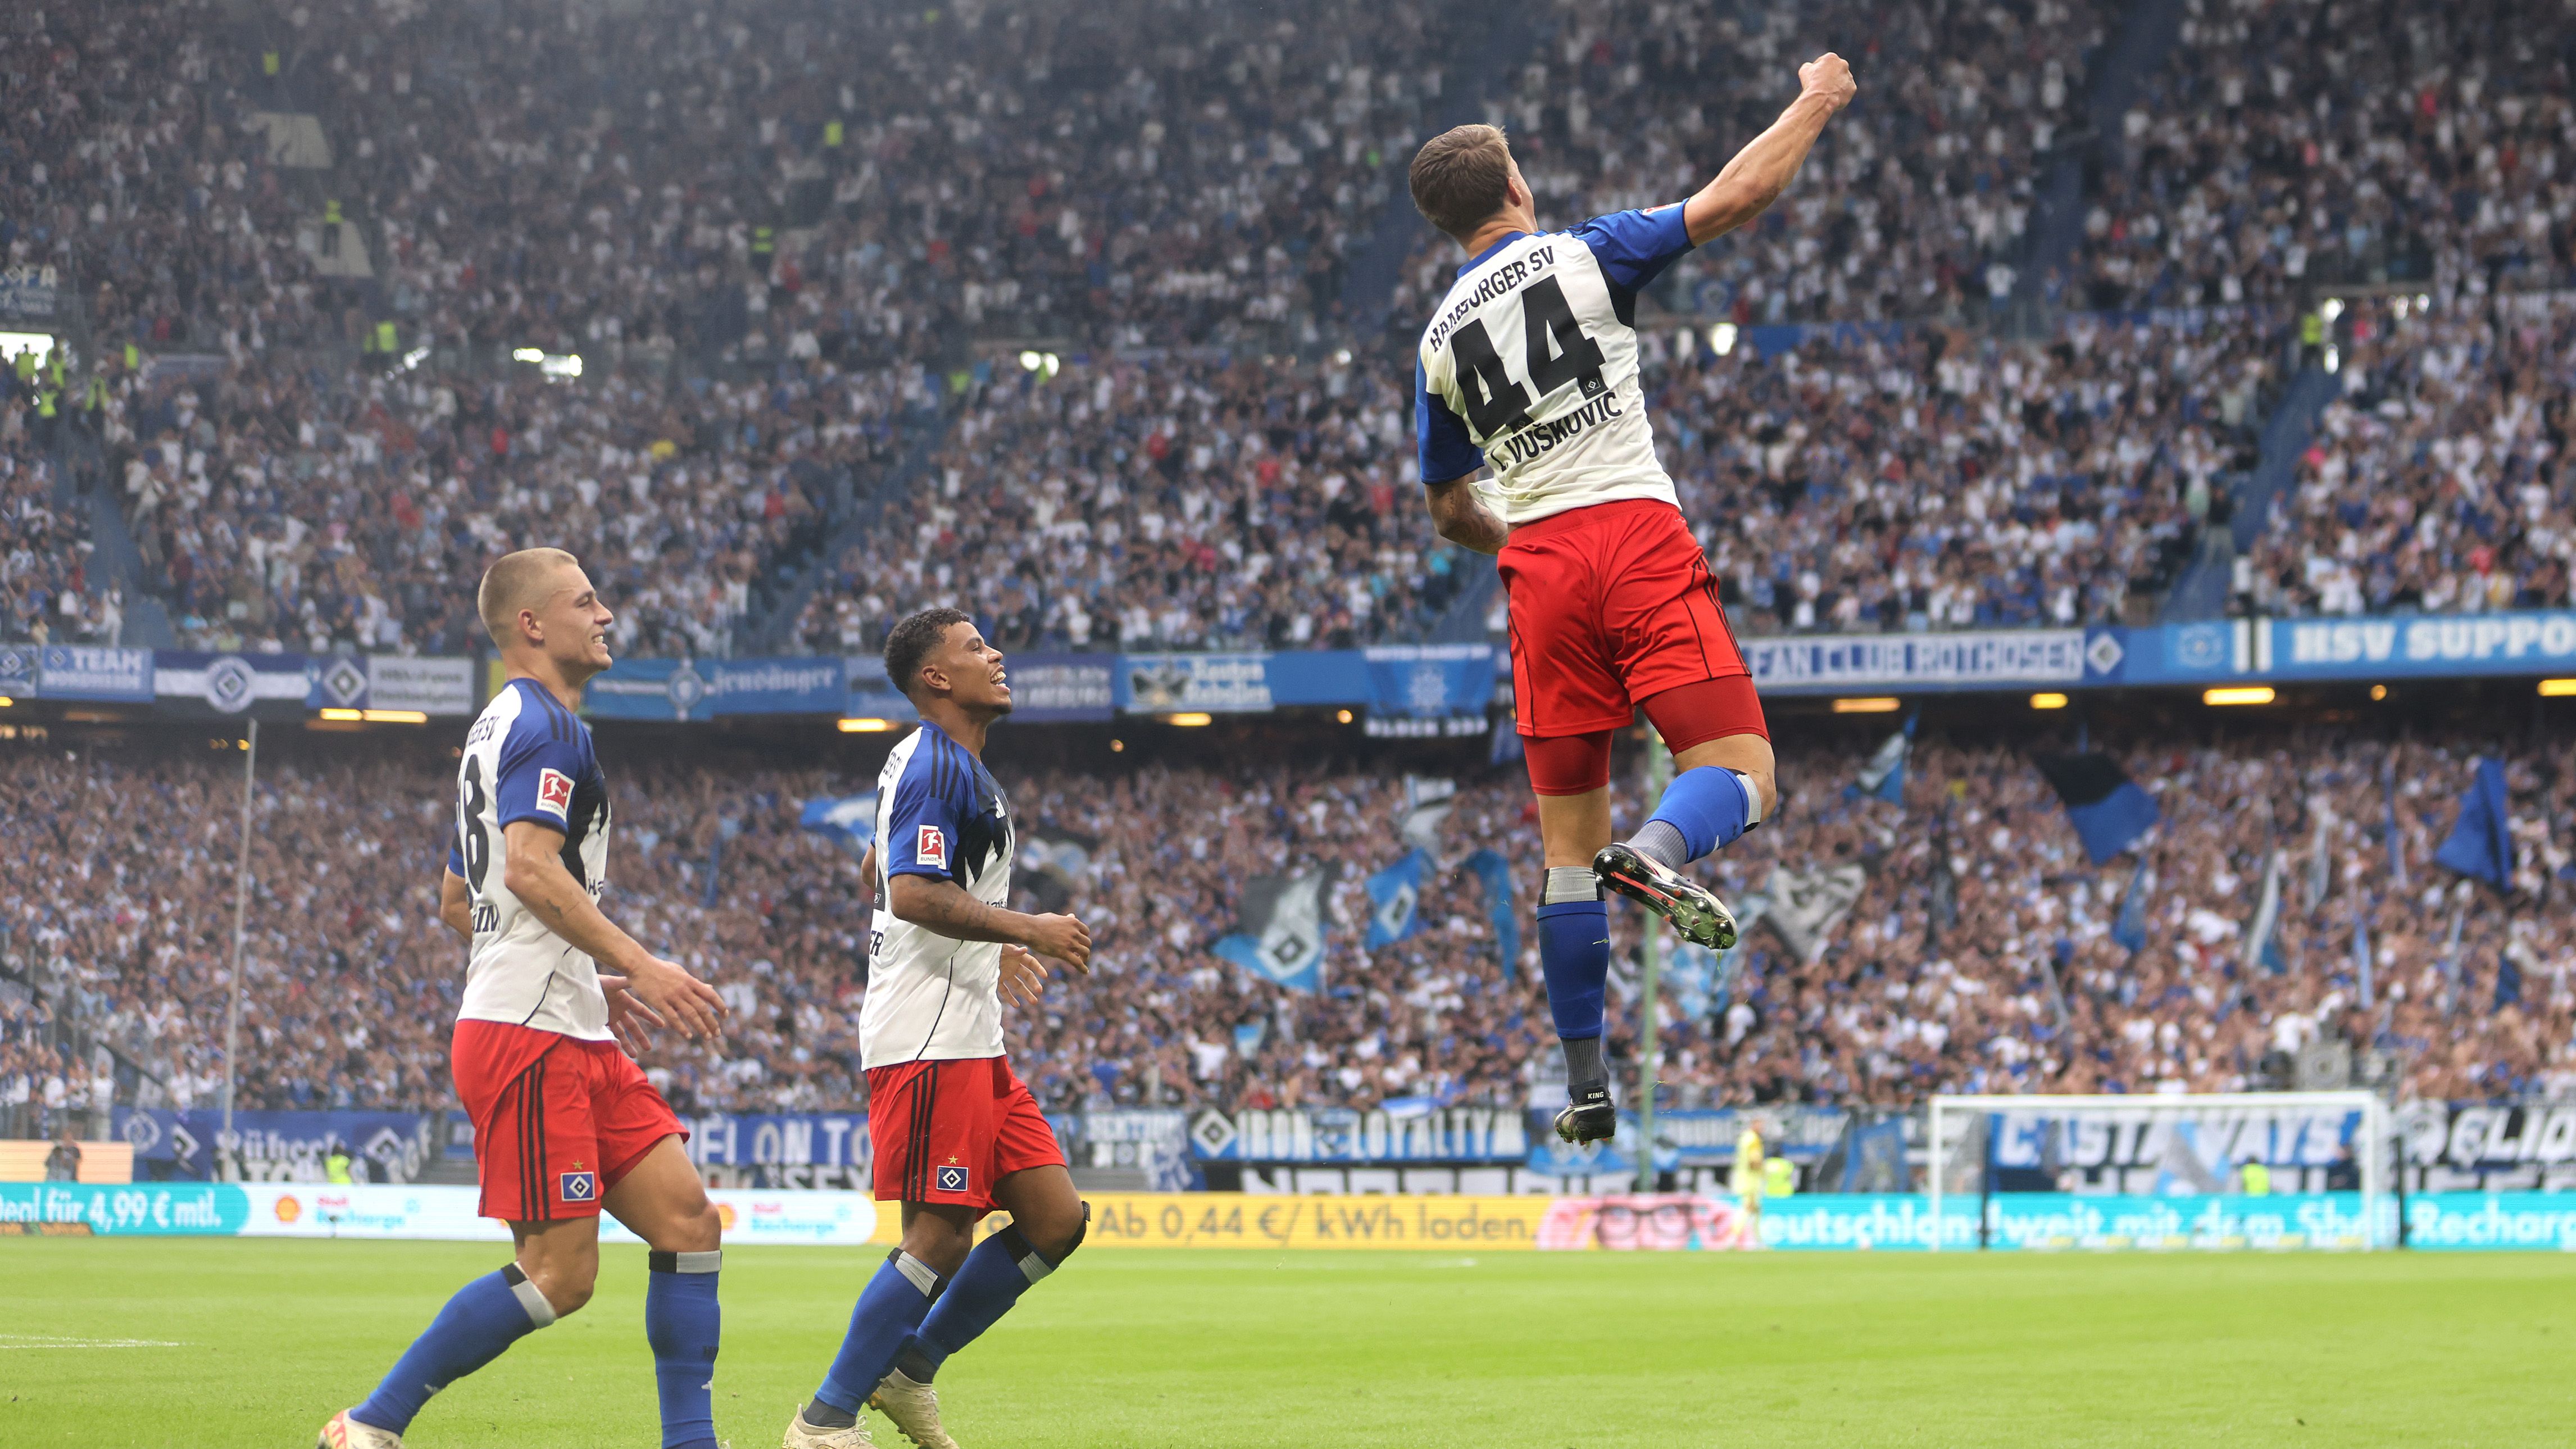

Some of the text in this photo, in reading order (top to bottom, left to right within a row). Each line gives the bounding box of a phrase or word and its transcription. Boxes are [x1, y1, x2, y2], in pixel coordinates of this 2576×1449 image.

[1529, 246, 1555, 271] SV
[1451, 274, 1609, 440] 44
[73, 649, 143, 671] TEAM
[1754, 632, 2082, 675] FAN CLUB ROTHOSEN
[2293, 622, 2396, 662] HSV
[1588, 1091, 1604, 1100] KING
[0, 1187, 222, 1232] eal für 4,99 € mtl.
[1096, 1203, 1148, 1239] Ab
[1159, 1204, 1243, 1247] 0,44
[1317, 1201, 1405, 1238] kWh
[1416, 1202, 1537, 1241] laden.
